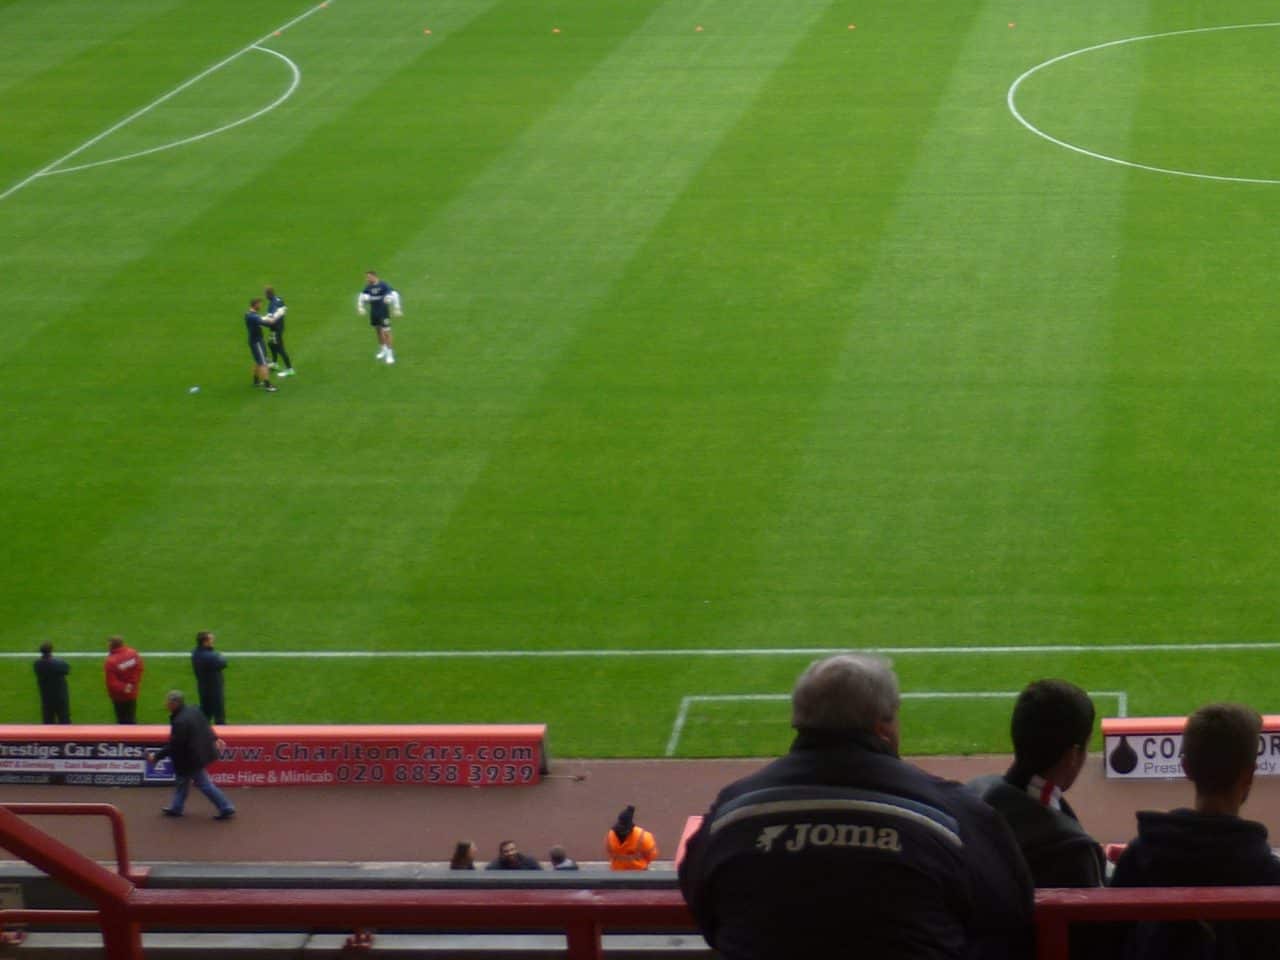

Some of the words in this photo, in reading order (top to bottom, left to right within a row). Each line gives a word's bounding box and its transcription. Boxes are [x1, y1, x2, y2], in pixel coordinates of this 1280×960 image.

[63, 743, 95, 757] Car
[97, 742, 143, 757] Sales
[217, 742, 533, 762] ww.CharltonCars.com
[237, 770, 265, 783] Hire
[267, 770, 278, 783] &
[280, 769, 333, 783] Minicab
[336, 764, 384, 782] 020
[468, 764, 534, 782] 3939
